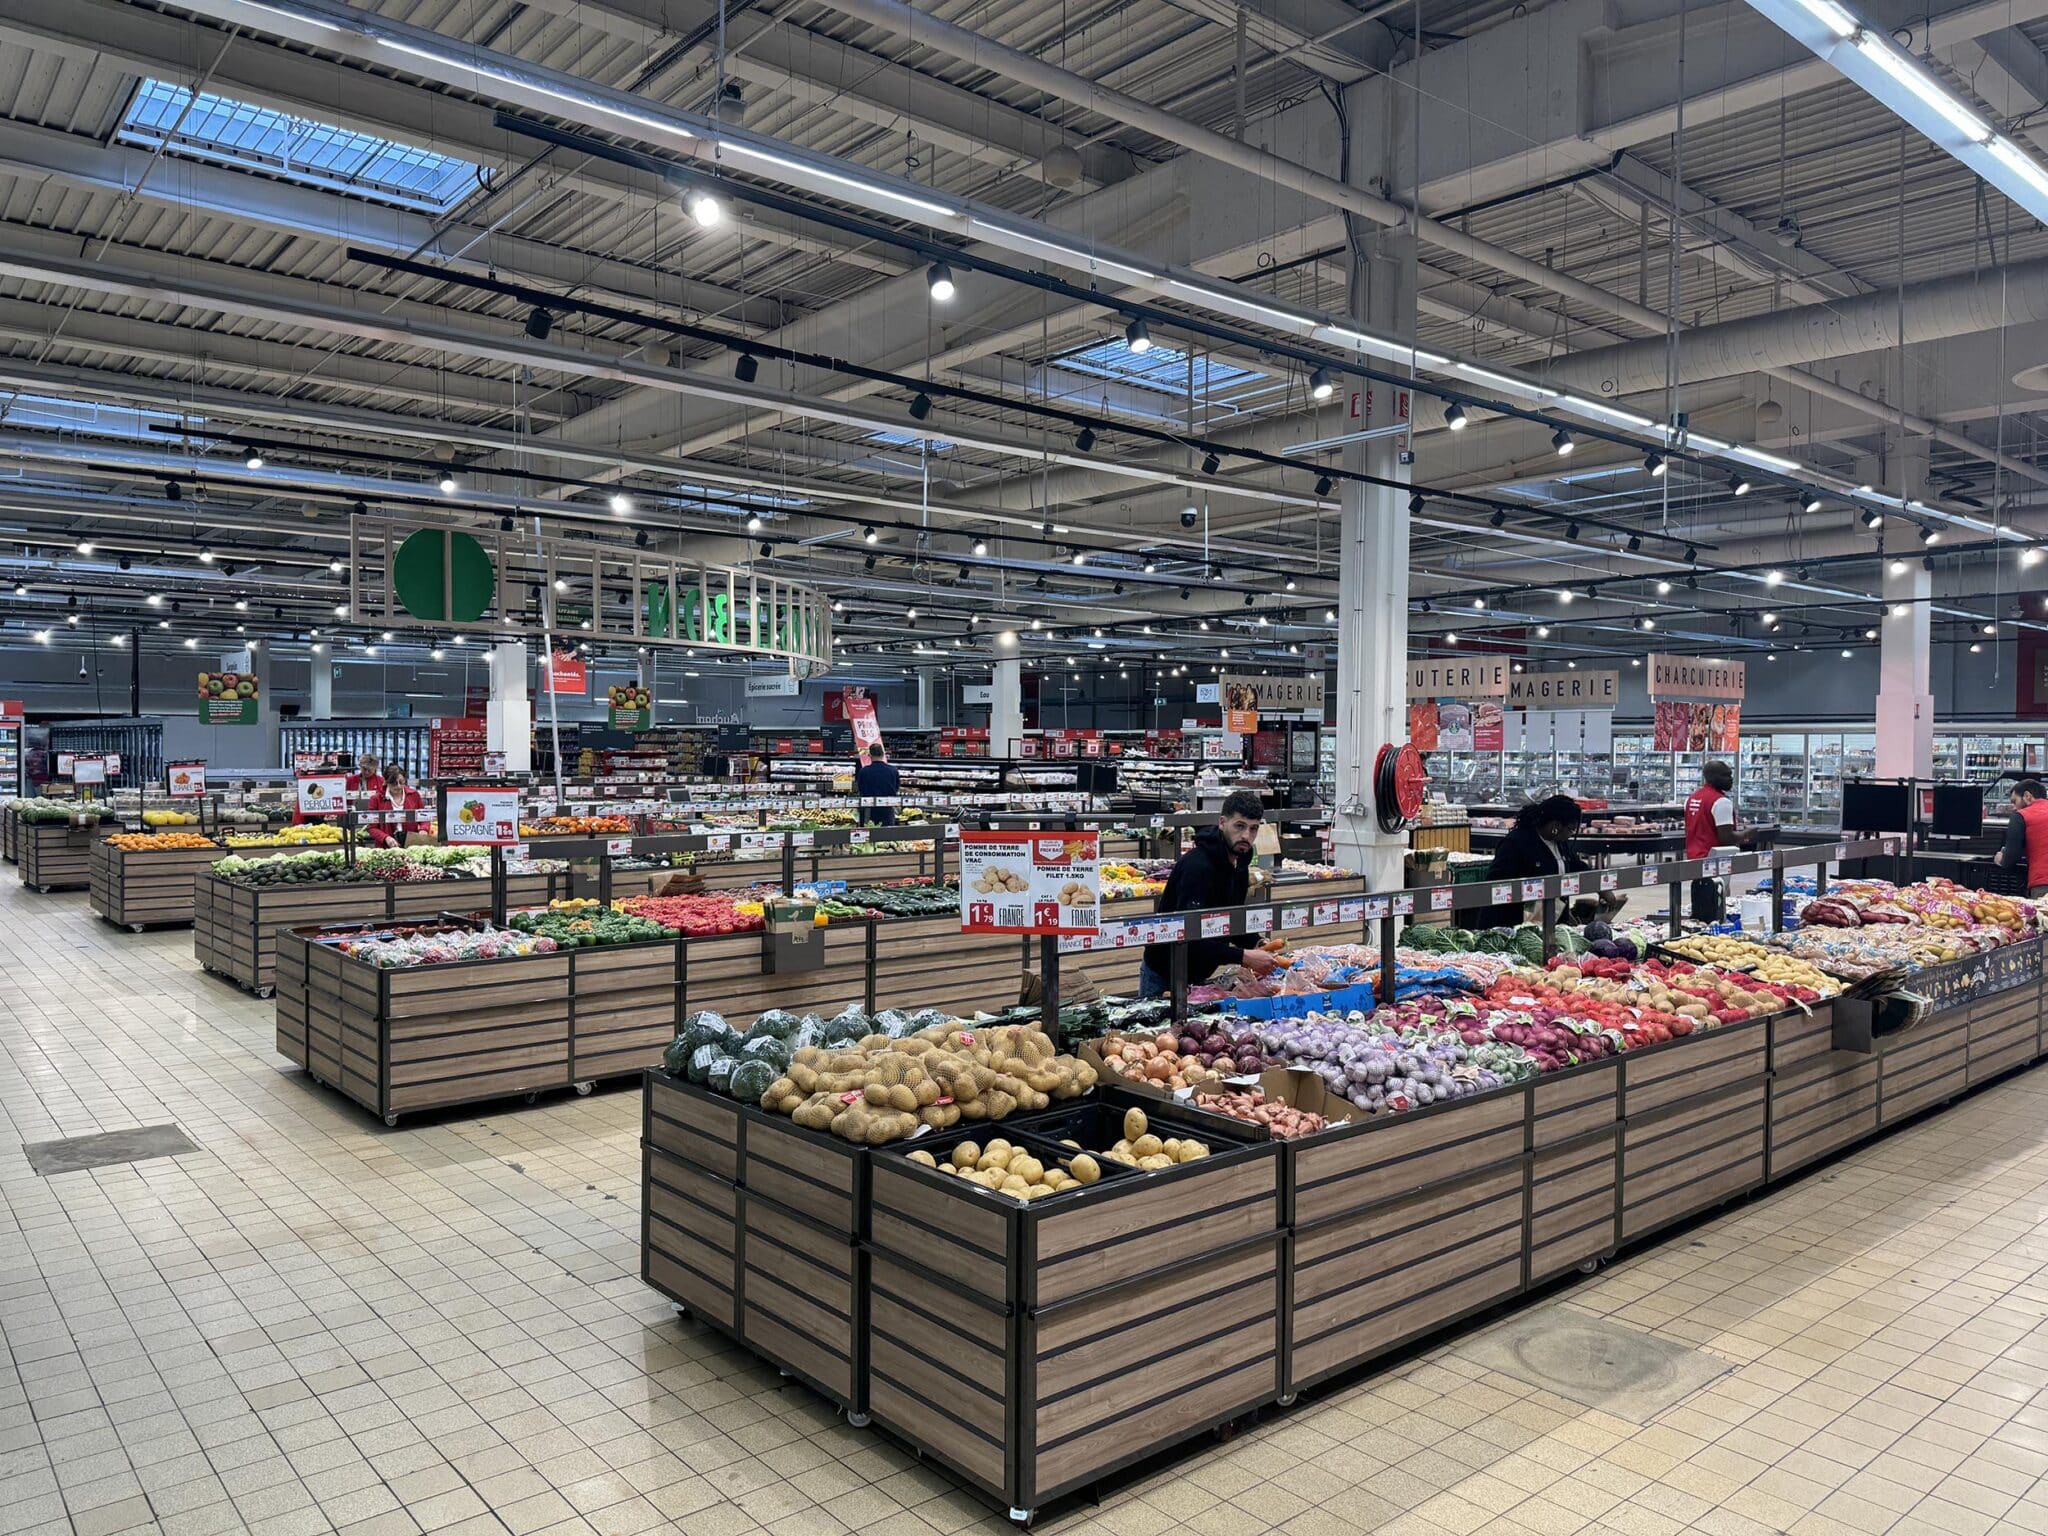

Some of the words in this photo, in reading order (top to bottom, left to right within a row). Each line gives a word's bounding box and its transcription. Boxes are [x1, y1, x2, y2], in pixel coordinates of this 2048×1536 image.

[1407, 667, 1503, 687] UTERIE
[1656, 665, 1743, 688] CHARCUTERIE
[1510, 679, 1612, 698] MAGERIE
[453, 824, 495, 836] ESPAGNE
[998, 908, 1024, 926] FRANCE
[1071, 909, 1097, 927] FRANCE
[1124, 933, 1147, 945] FRANCE
[1155, 930, 1177, 941] FRANCE
